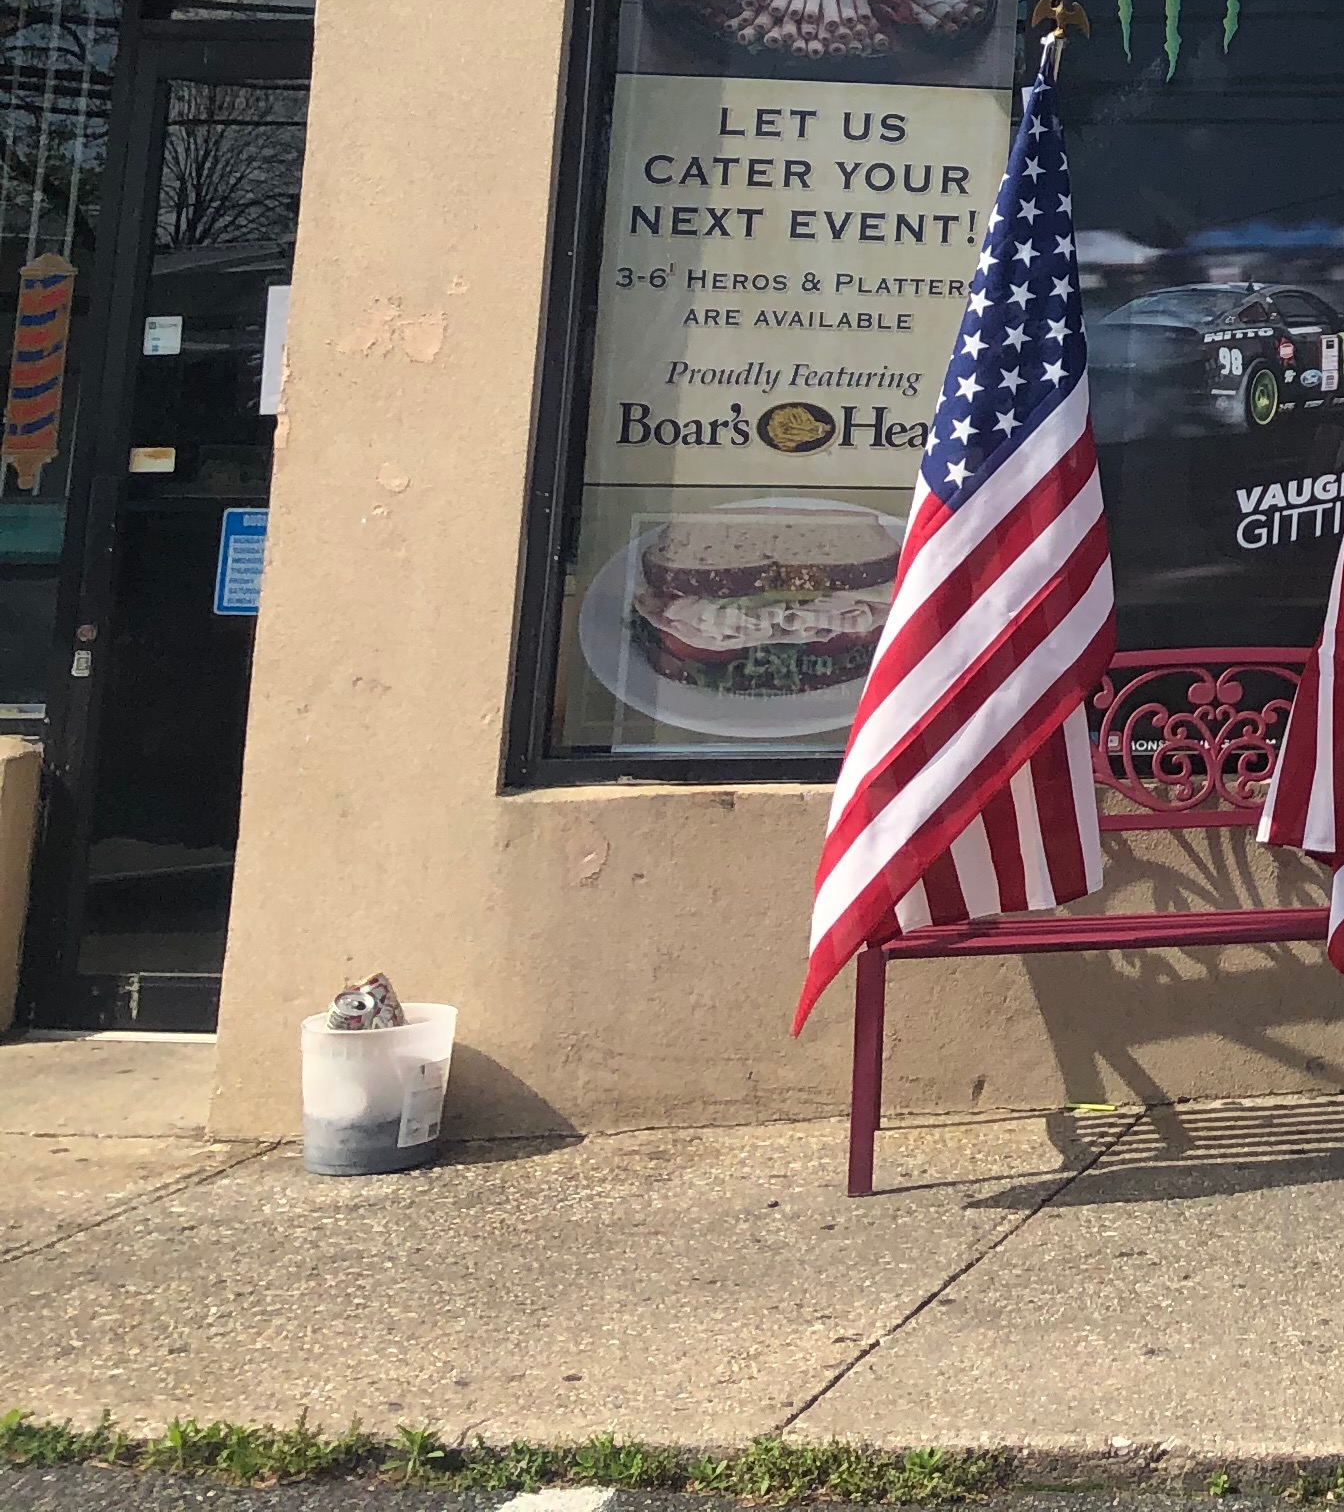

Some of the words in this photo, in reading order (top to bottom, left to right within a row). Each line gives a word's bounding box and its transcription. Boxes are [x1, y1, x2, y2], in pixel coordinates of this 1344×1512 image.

[718, 106, 818, 139] LET
[843, 111, 907, 143] US
[643, 154, 813, 189] CATER
[834, 161, 971, 195] YOUR
[630, 205, 765, 239] NEXT
[789, 209, 979, 245] EVENT!
[687, 269, 789, 292] HEROS
[801, 271, 822, 294] &
[683, 308, 741, 328] ARE
[753, 309, 914, 331] AVAILABLE
[665, 360, 783, 394] Proudly
[788, 362, 923, 396] Featuring
[1218, 346, 1243, 376] 98
[616, 400, 752, 448] Boar's
[838, 405, 930, 449] Hea
